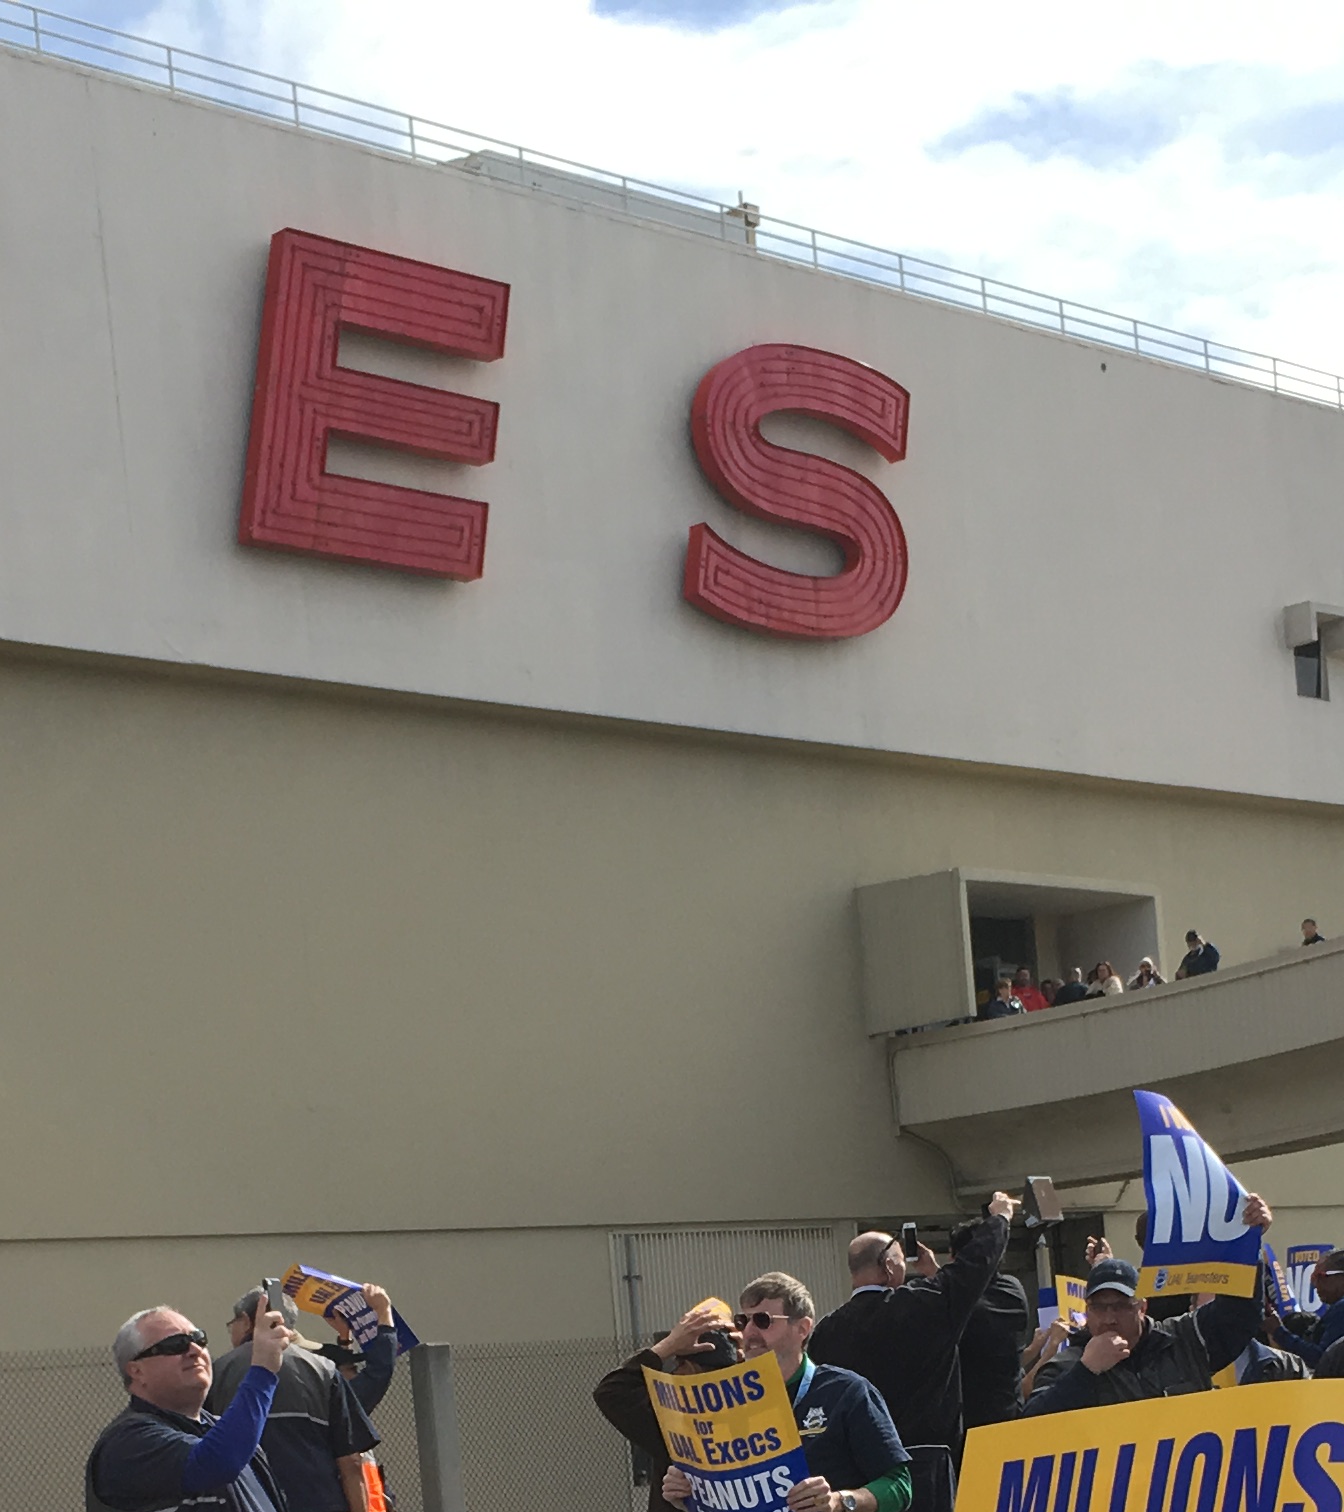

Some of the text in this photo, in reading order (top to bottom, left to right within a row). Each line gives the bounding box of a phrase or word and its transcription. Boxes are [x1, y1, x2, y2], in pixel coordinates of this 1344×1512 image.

[1150, 1134, 1252, 1245] NO
[1186, 1271, 1230, 1284] Teamsters
[652, 1370, 765, 1414] MILLIONS
[668, 1427, 782, 1465] UAL Execs
[693, 1418, 714, 1436] for
[685, 1465, 795, 1511] PEANUTS
